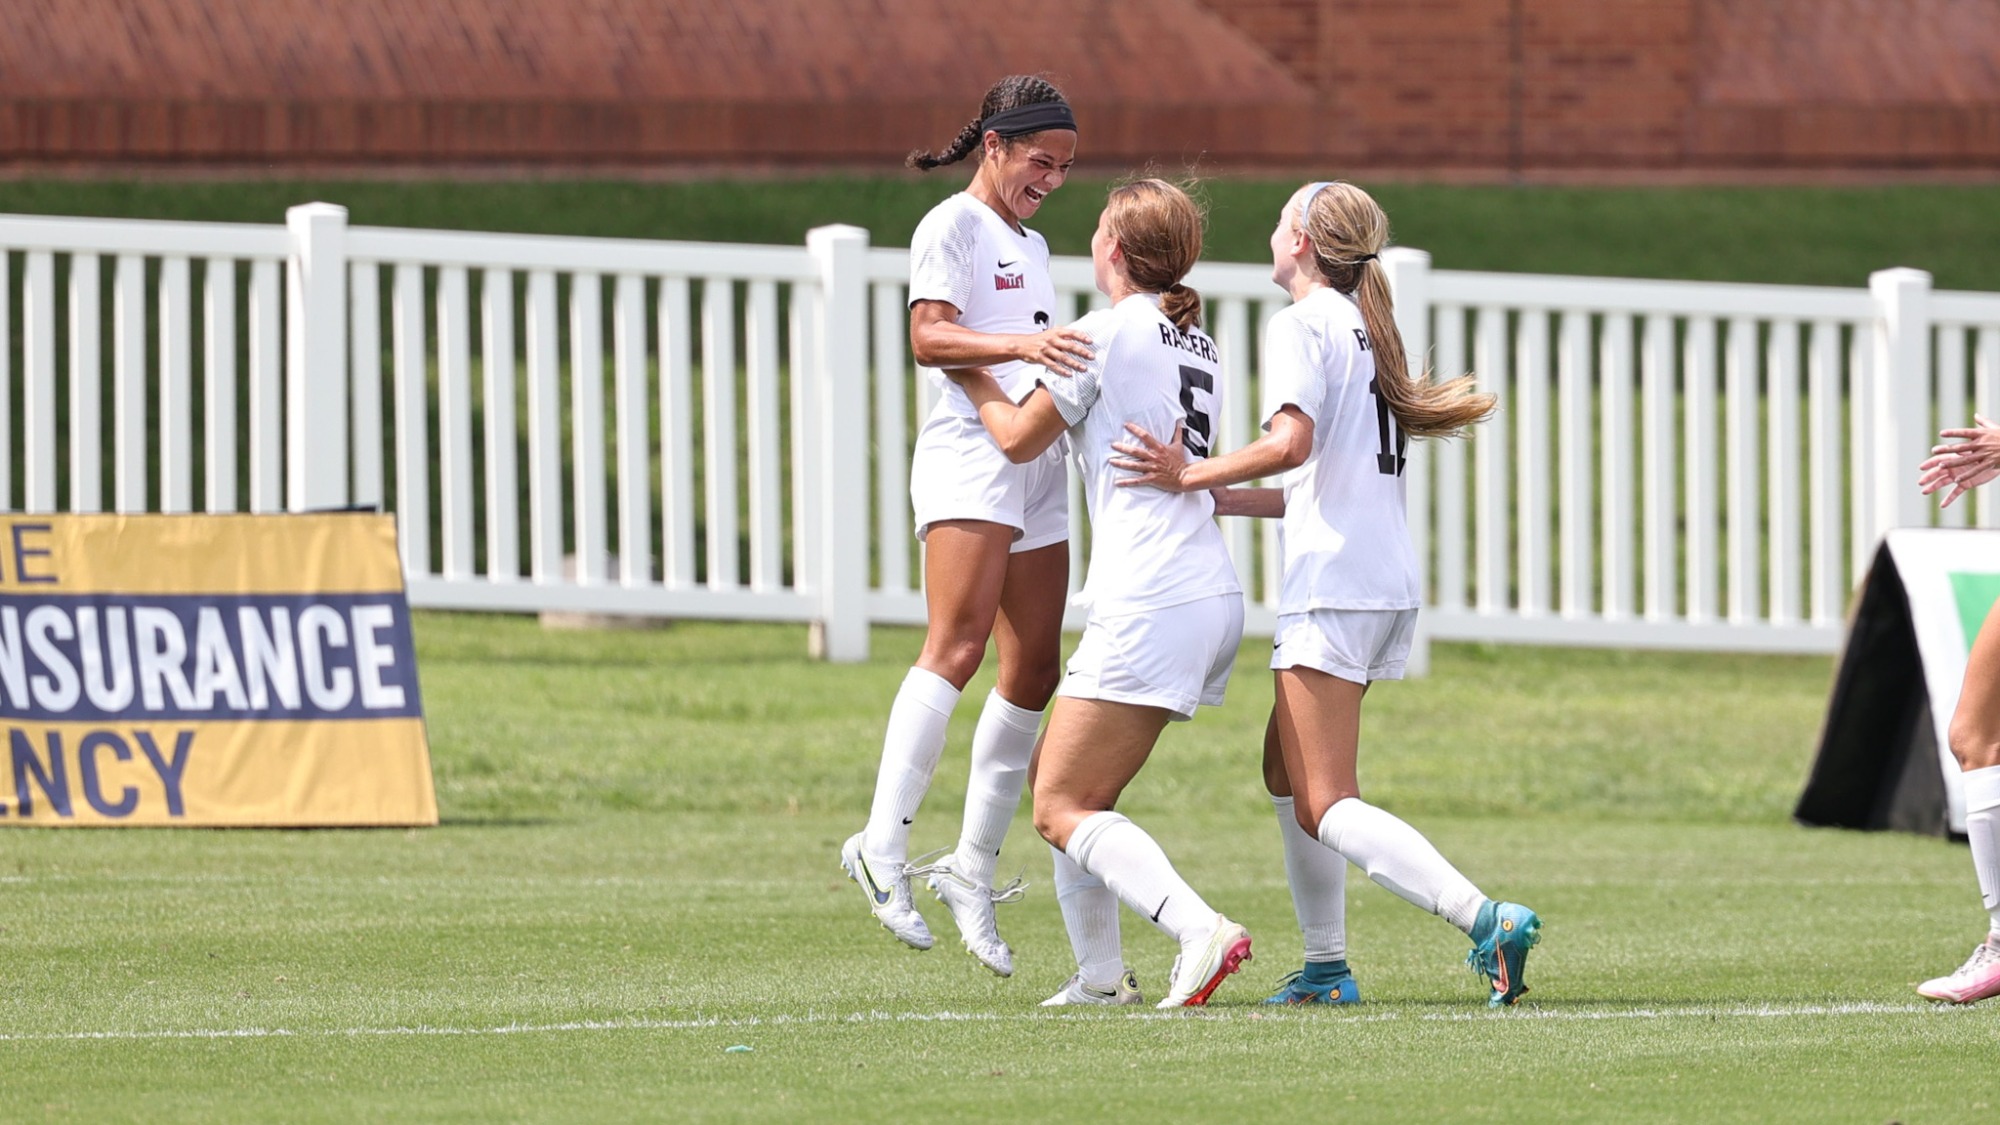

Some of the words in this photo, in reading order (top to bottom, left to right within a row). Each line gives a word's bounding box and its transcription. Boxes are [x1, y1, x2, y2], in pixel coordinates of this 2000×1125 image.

[994, 273, 1024, 291] VALLEY
[1158, 322, 1218, 364] RACERS
[1178, 364, 1214, 459] 5
[0, 728, 196, 818] NCY
